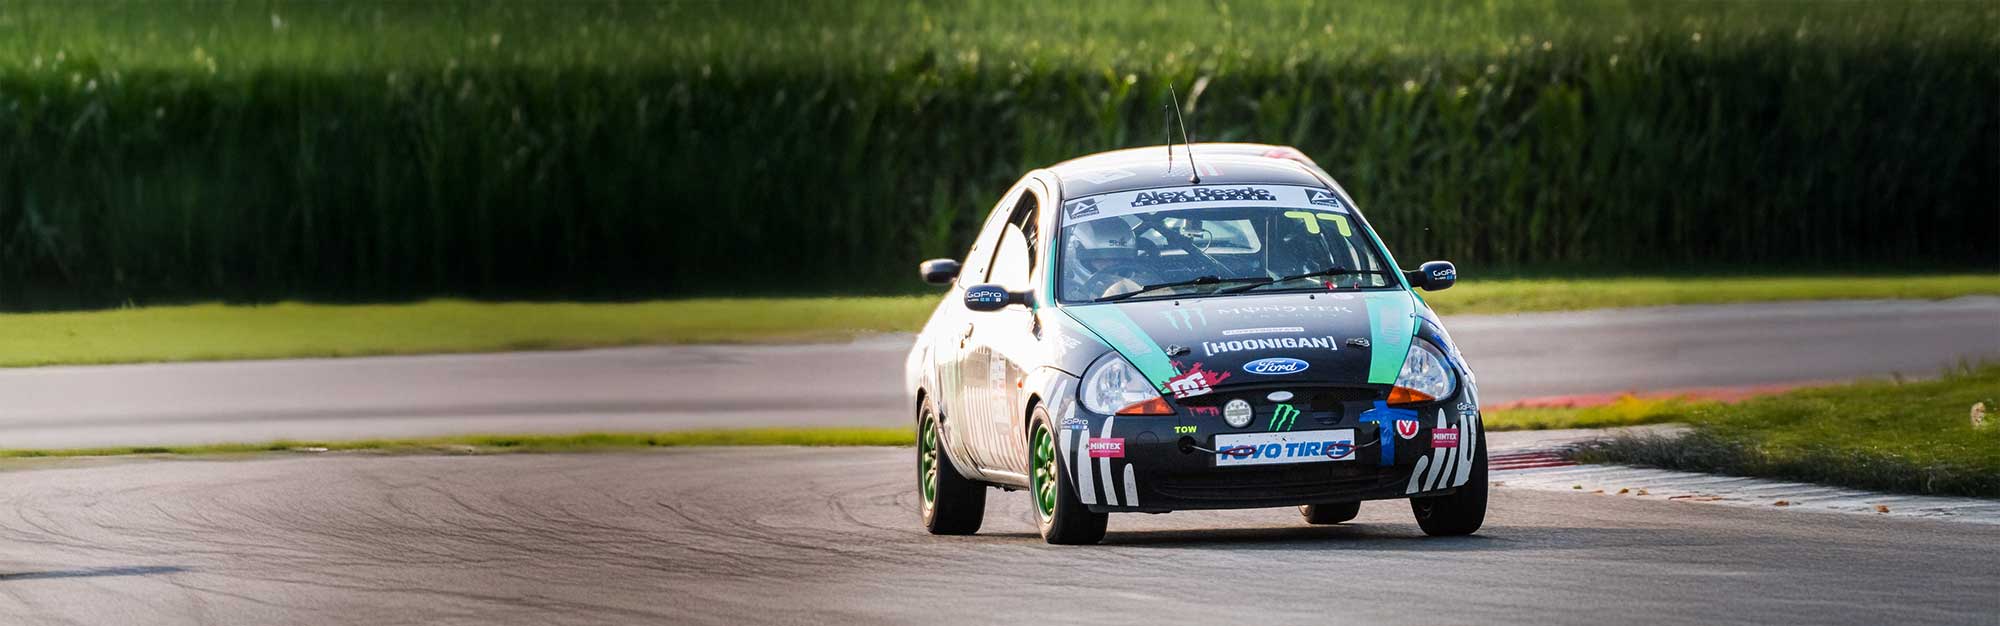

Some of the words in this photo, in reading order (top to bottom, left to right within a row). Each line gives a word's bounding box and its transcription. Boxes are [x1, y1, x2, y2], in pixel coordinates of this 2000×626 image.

[1134, 194, 1274, 206] MOTORSPORT
[1135, 190, 1190, 203] Alex
[1192, 187, 1270, 200] Reade
[1284, 211, 1352, 237] 77
[967, 290, 1002, 298] GoPro
[1255, 360, 1297, 374] Ford
[1060, 417, 1089, 425] GoPro
[1174, 425, 1198, 434] TOW
[1433, 432, 1457, 441] MINTEX
[1090, 442, 1121, 450] MINTEX
[1220, 442, 1282, 460] TOYO
[1285, 440, 1351, 457] TIRES
